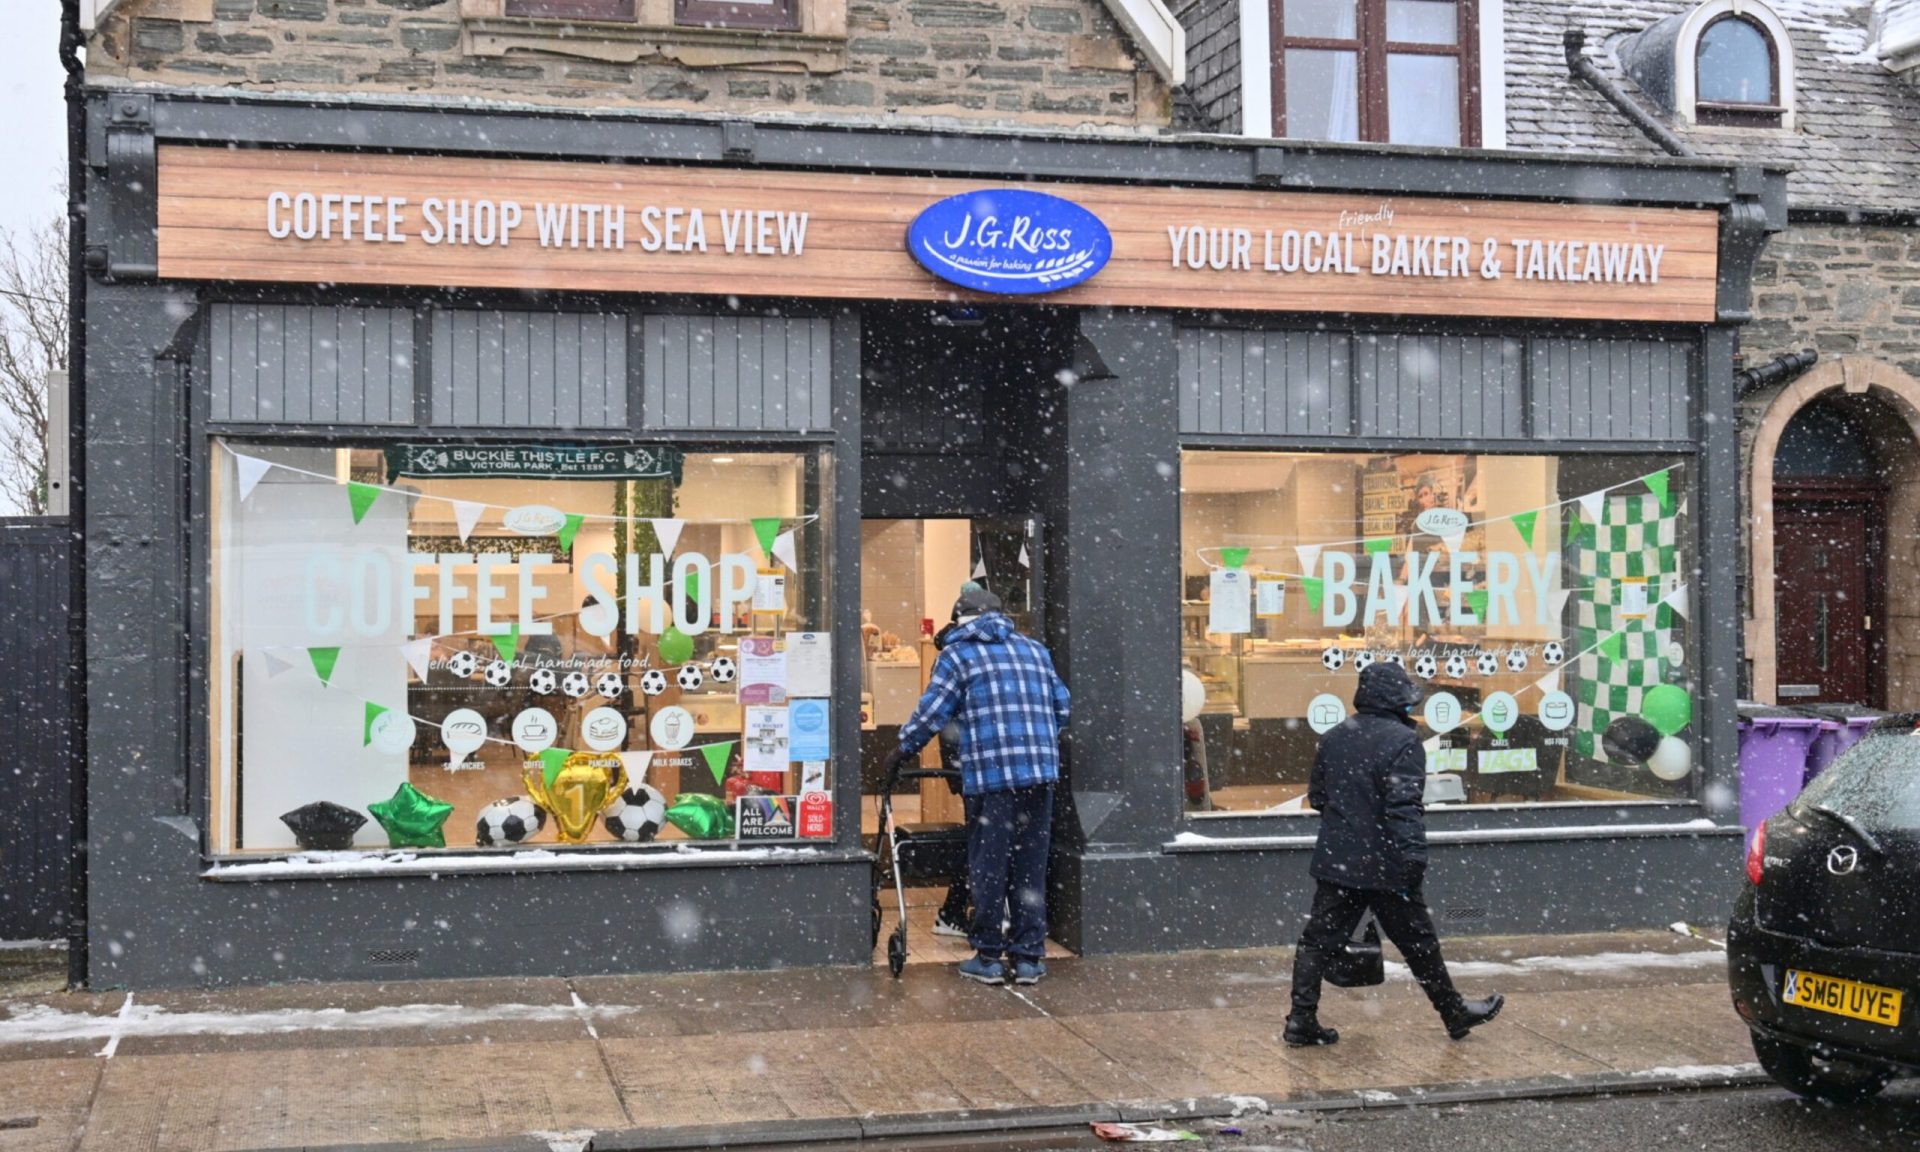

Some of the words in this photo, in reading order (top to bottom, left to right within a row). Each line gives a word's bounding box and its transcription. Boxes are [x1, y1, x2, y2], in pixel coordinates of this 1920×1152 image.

[266, 191, 406, 243] COFFEE
[420, 197, 522, 247] SHOP
[535, 202, 625, 250] WITH
[639, 206, 707, 252] SEA
[719, 209, 809, 256] VIEW
[1339, 203, 1394, 230] friendly
[1167, 225, 1253, 270] YOUR
[1264, 229, 1360, 275] LOCAL
[1371, 233, 1470, 278] BAKER
[1480, 237, 1502, 279] &
[1511, 239, 1664, 283] TAKEAWAY
[956, 255, 988, 267] passion
[987, 257, 1002, 270] for
[1002, 258, 1032, 272] baking
[453, 450, 515, 461] BUCKIE
[520, 450, 585, 463] THISTLE
[590, 452, 619, 463] F.C.
[470, 461, 521, 469] VICTORIA
[524, 462, 552, 470] PARK
[305, 551, 553, 635] COFFEE
[579, 552, 758, 637] SHOP
[1323, 551, 1559, 627] BAKERY
[535, 652, 612, 669] handmade
[617, 652, 651, 671] food.
[588, 759, 621, 768] PANCAKES
[652, 758, 667, 767] MILK
[669, 758, 693, 767] SHAKES
[742, 808, 761, 816] ALL
[742, 817, 763, 826] ARE
[742, 826, 793, 835] WELCOME
[1801, 977, 1846, 1010] SM61
[1850, 987, 1894, 1019] UYE
